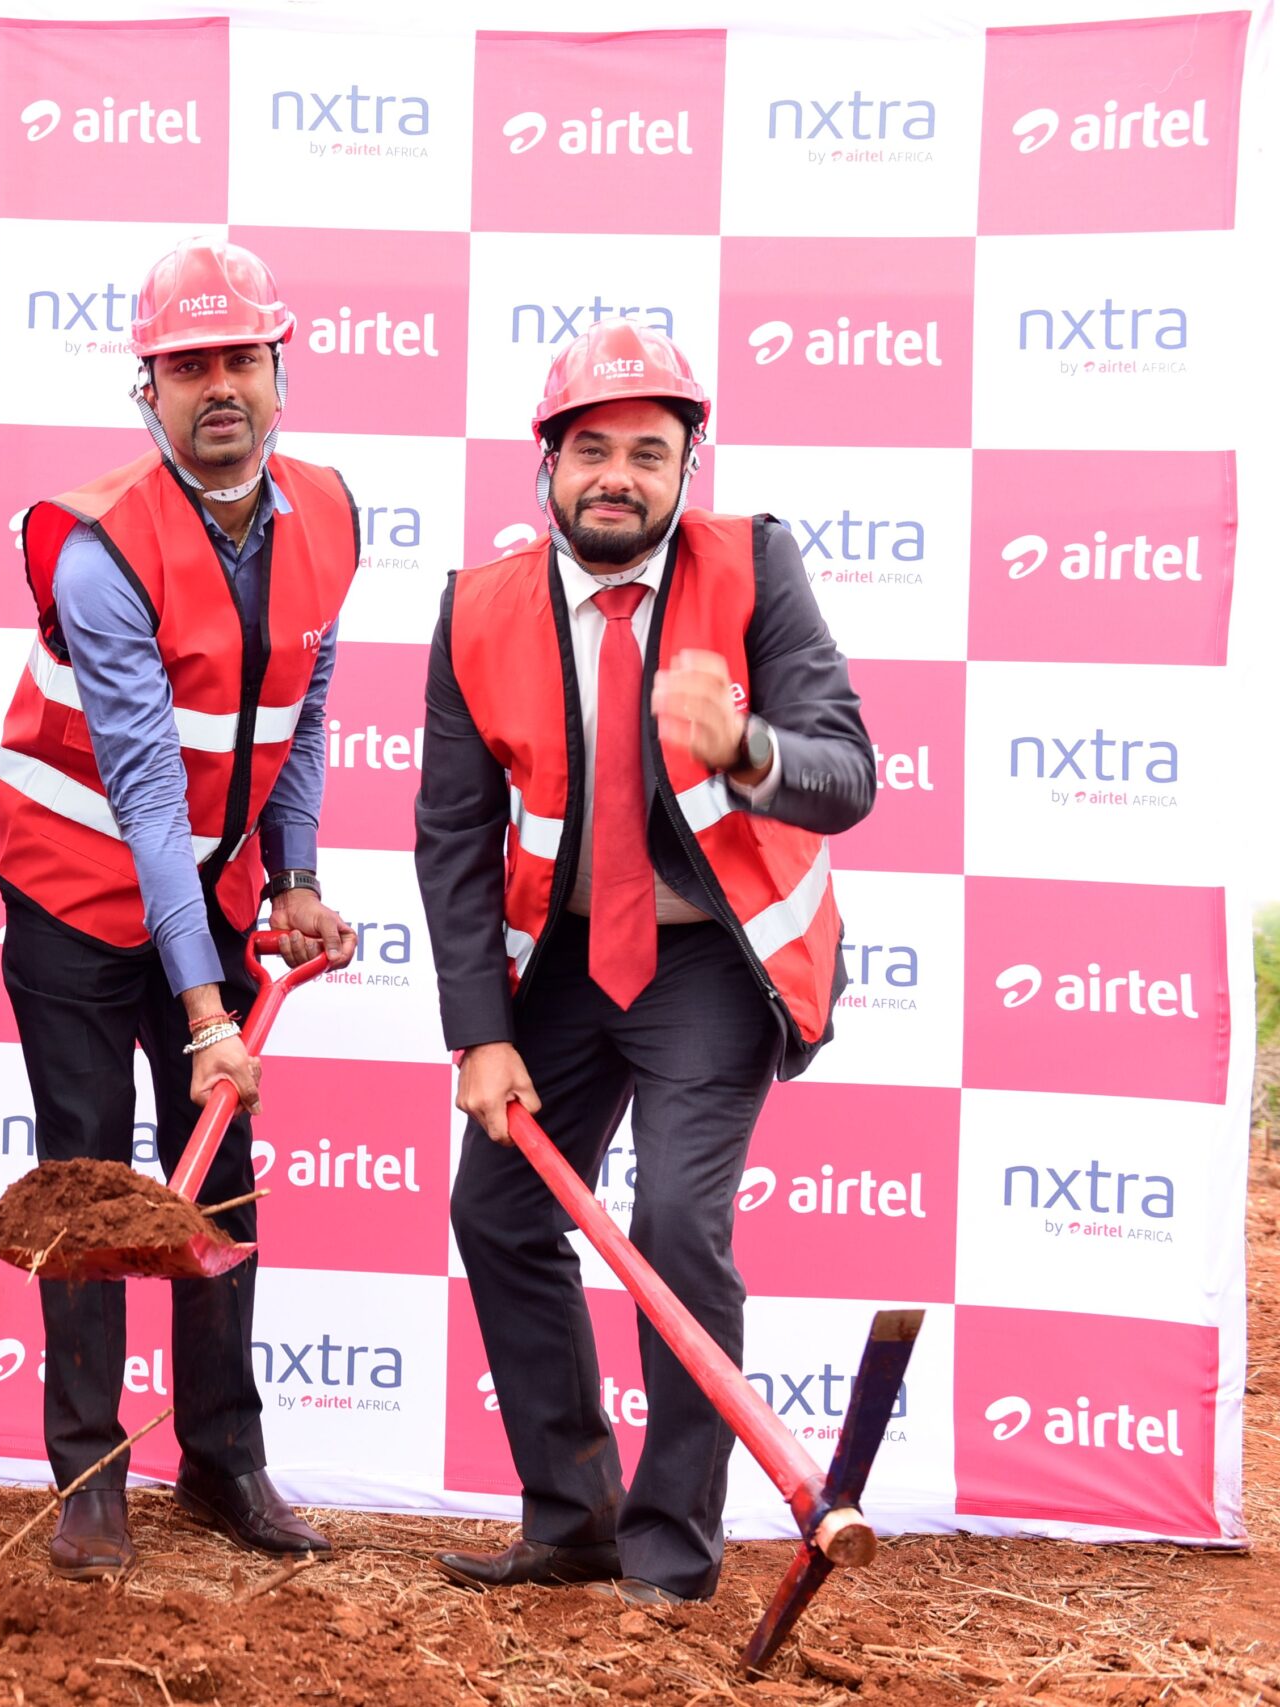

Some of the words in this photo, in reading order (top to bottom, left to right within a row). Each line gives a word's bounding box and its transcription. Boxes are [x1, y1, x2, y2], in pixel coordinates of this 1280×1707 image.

[73, 97, 200, 144] airtel
[273, 85, 428, 135] nxtra
[559, 108, 692, 154] airtel
[769, 91, 935, 139] nxtra
[1071, 100, 1208, 151] airtel
[310, 141, 326, 157] by
[345, 143, 381, 156] airtel
[386, 146, 428, 158] AFRICA
[808, 150, 826, 165] by
[846, 150, 883, 163] airtel
[888, 152, 933, 162] AFRICA
[179, 293, 227, 313] nxtra
[1020, 299, 1186, 350] nxtra
[65, 341, 81, 356] by
[309, 307, 438, 356] airtel
[806, 317, 942, 366] airtel
[593, 358, 645, 377] nxtra
[1061, 361, 1078, 376] by
[1098, 360, 1136, 373] airtel
[1143, 363, 1186, 373] AFRICA
[779, 510, 924, 562] xtra
[1060, 531, 1201, 581] airtel
[377, 558, 420, 570] AFRICA
[835, 570, 873, 584] airtel
[878, 573, 923, 585] AFRICA
[328, 720, 424, 771] irtel
[1011, 729, 1177, 783] nxtra
[1052, 789, 1069, 806] by
[1089, 791, 1128, 805] airtel
[1133, 795, 1177, 807] AFRICA
[326, 971, 362, 985] airtel
[367, 975, 410, 987] AFRICA
[1055, 963, 1198, 1018] airtel
[872, 998, 917, 1010] AFRICA
[288, 1139, 419, 1191] airtel
[789, 1165, 926, 1217] airtel
[1004, 1160, 1174, 1218] nxtra
[1045, 1220, 1064, 1237] by
[1084, 1222, 1123, 1238] airtel
[1127, 1228, 1173, 1243] AFRICA
[278, 1393, 296, 1410] by
[315, 1394, 352, 1409] airtel
[357, 1399, 401, 1411] AFRICA
[1045, 1397, 1183, 1456] airtel
